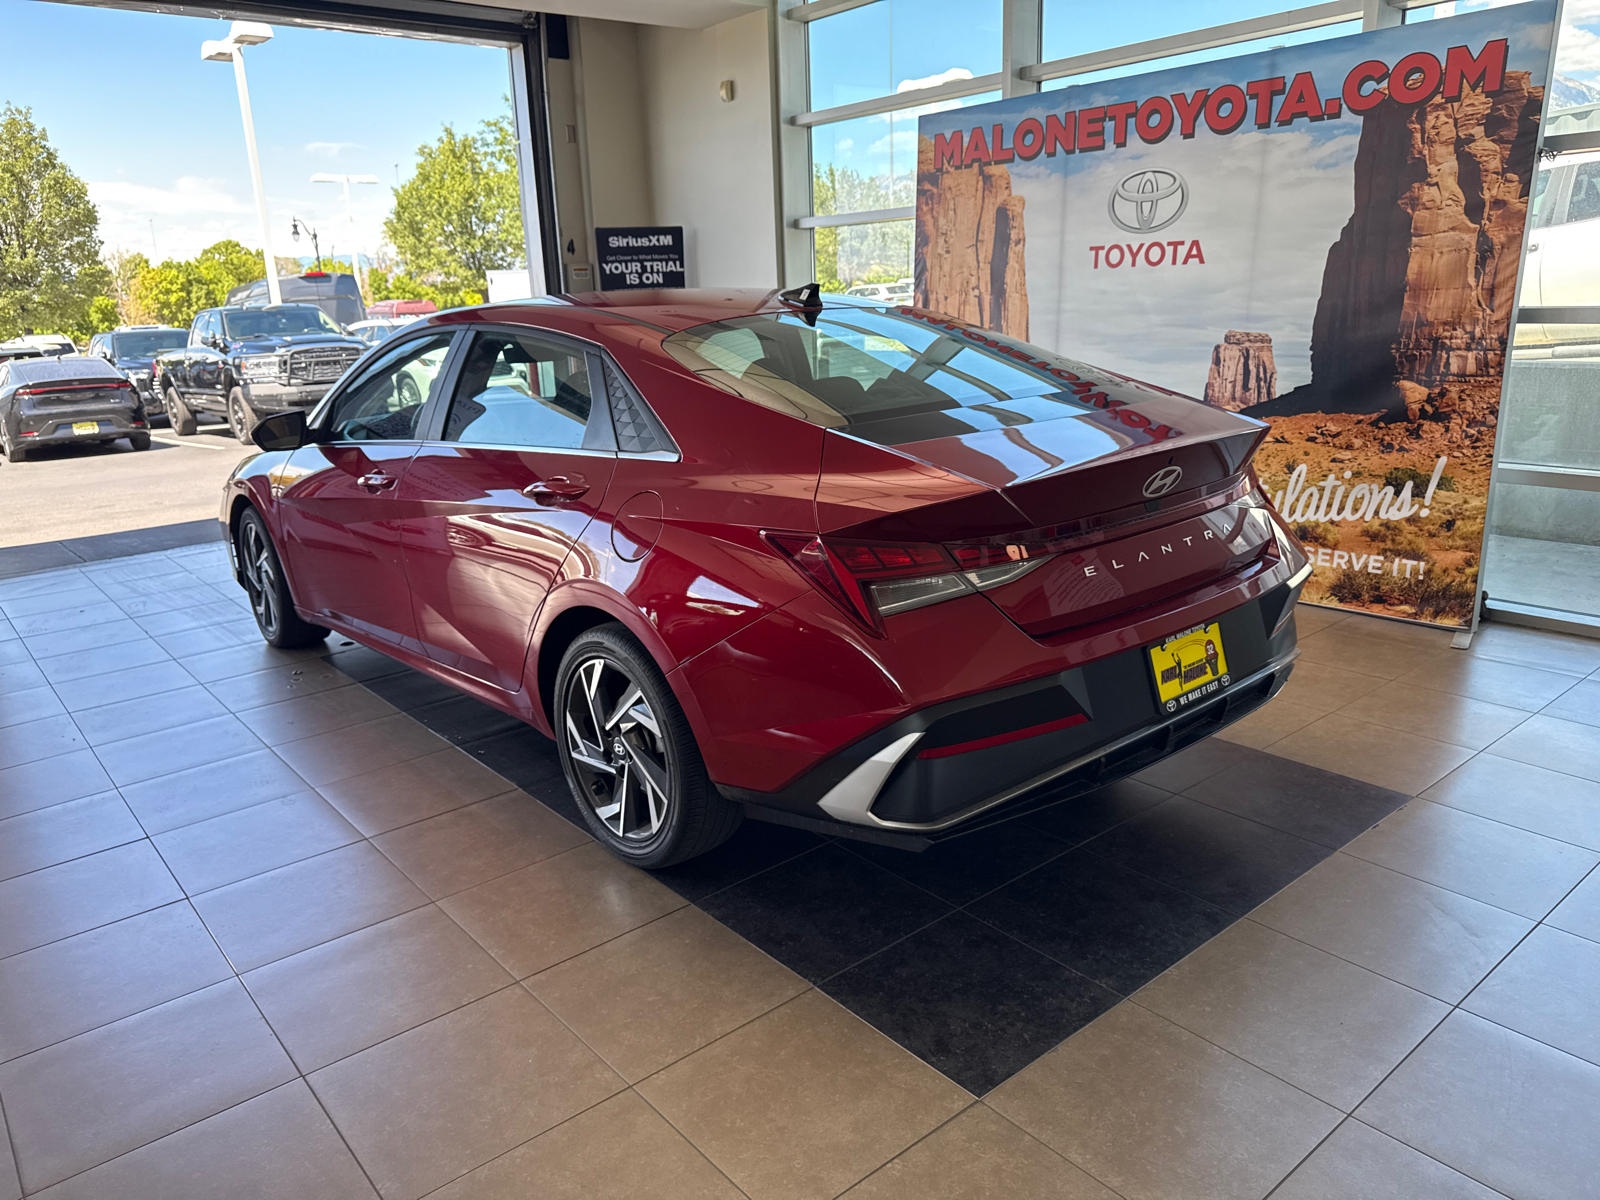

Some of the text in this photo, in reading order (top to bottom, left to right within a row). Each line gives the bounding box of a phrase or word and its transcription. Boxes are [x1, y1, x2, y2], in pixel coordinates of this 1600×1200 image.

[934, 38, 1509, 172] MALONETOYOTA.COM
[608, 234, 673, 248] SiriusXM
[1089, 239, 1206, 269] TOYOTA
[602, 261, 642, 275] YOUR
[643, 260, 685, 273] TRIAL
[626, 272, 664, 285] IS ON
[1259, 455, 1448, 523] ulations!
[1083, 523, 1233, 578] ELANTRA
[1392, 558, 1426, 580] IT!
[1206, 644, 1214, 655] 32
[1179, 680, 1219, 705] WE MAKE IT EASY
